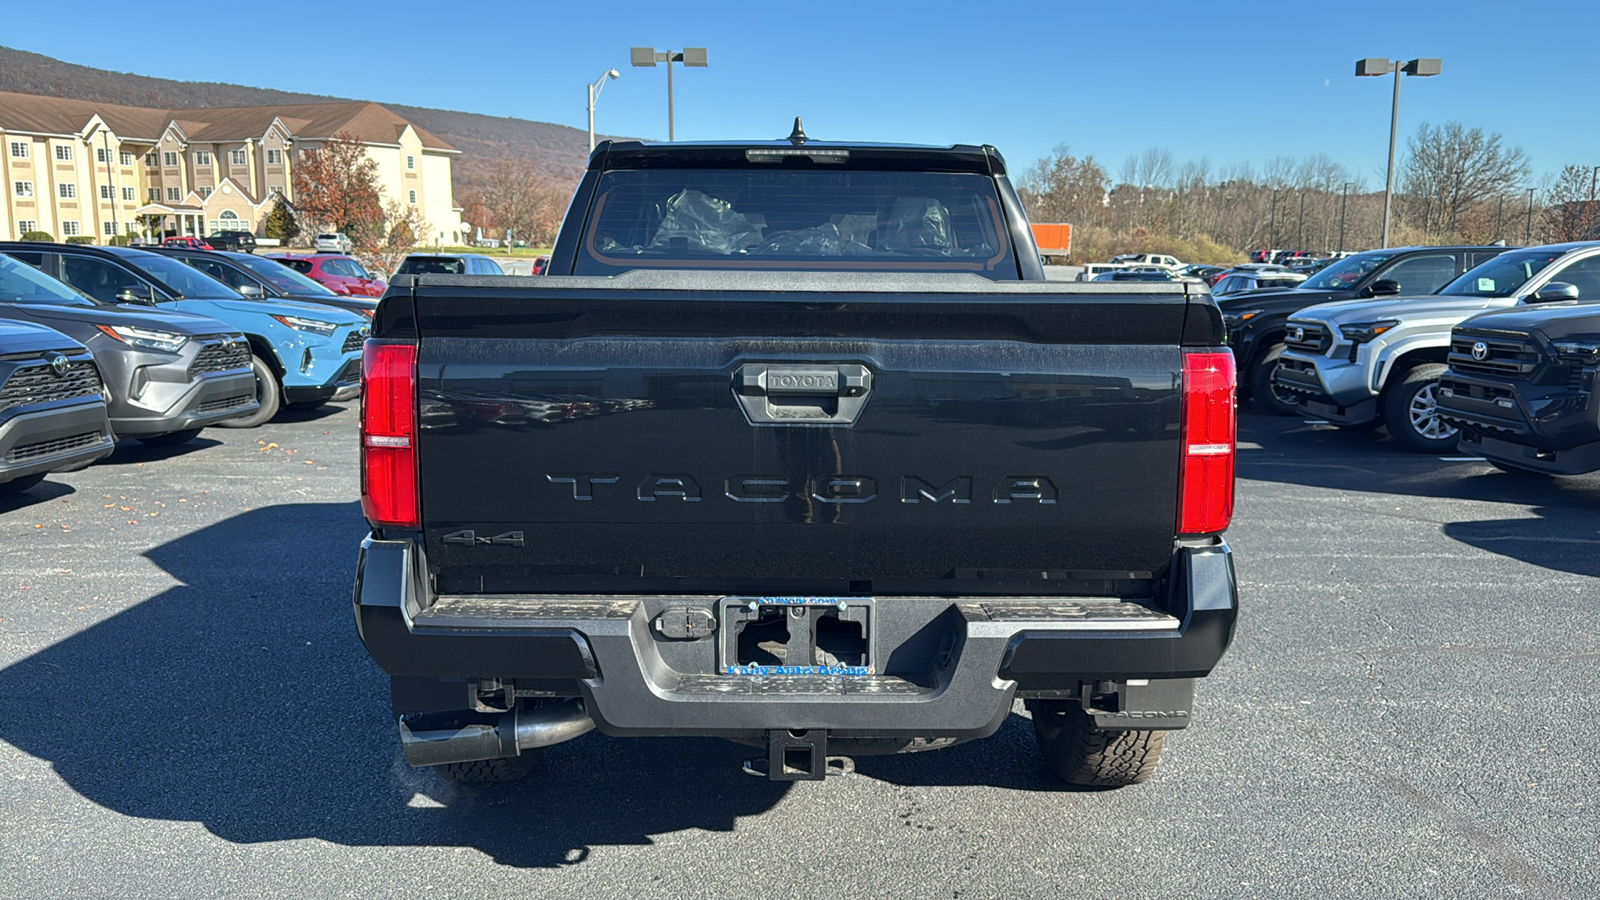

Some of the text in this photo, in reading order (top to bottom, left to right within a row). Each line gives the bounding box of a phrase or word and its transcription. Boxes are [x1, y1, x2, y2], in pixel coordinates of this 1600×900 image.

[770, 374, 836, 388] TOYOTA
[546, 472, 1060, 504] TACOMA
[443, 529, 524, 547] 4x4
[774, 666, 813, 676] Auto
[818, 666, 868, 678] Group
